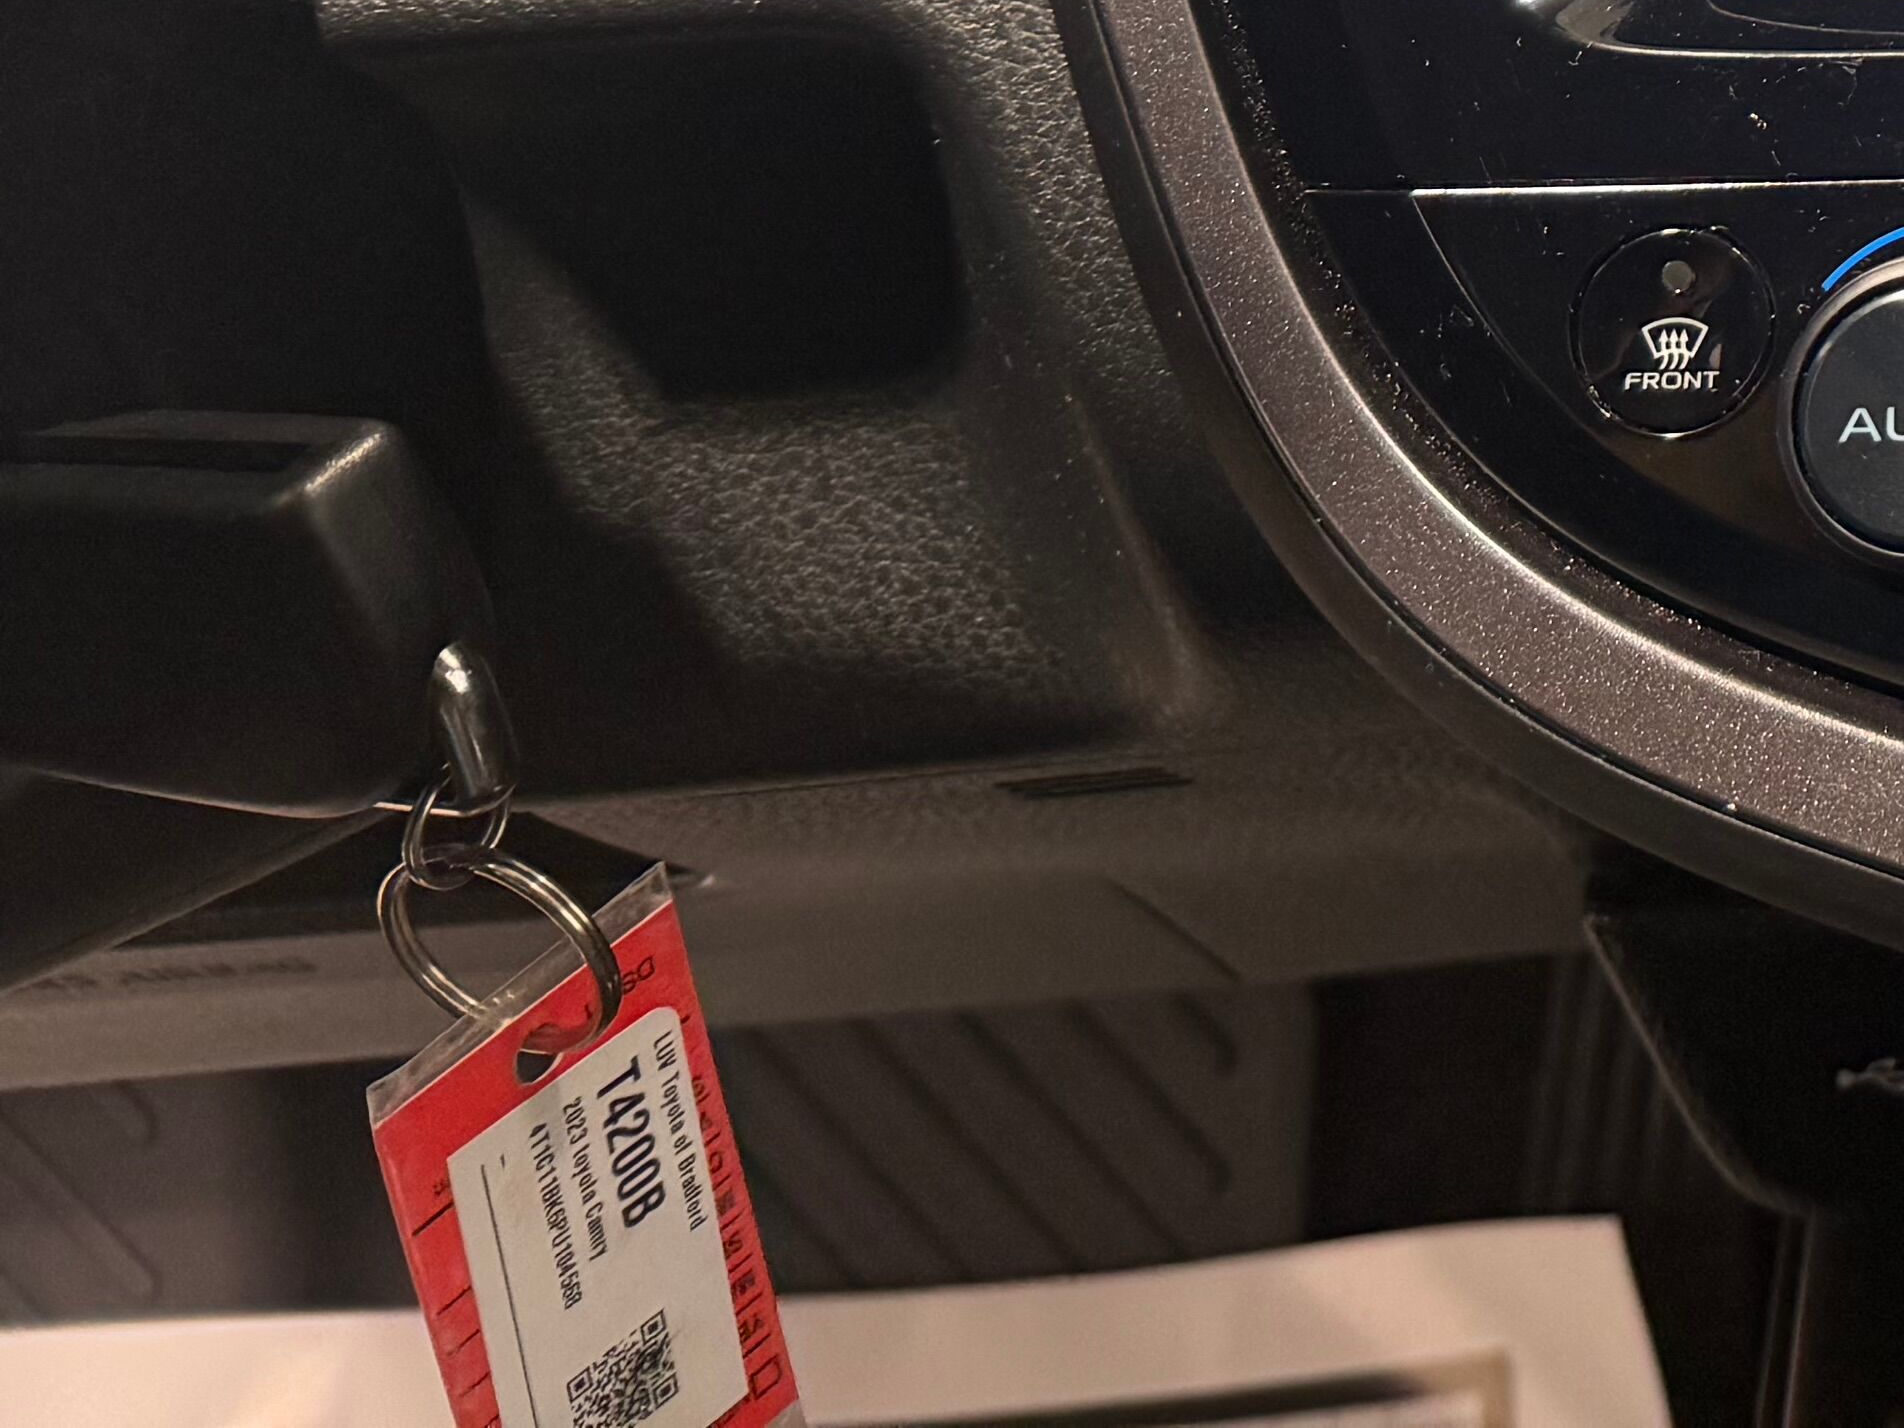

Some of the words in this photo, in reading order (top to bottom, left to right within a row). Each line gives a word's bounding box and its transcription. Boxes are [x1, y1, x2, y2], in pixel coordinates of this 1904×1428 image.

[1624, 370, 1720, 392] FRONT
[653, 1030, 677, 1072] LUV
[660, 1071, 685, 1136] Toyota
[597, 1054, 667, 1229] T4200B
[673, 1133, 693, 1156] of
[563, 1095, 588, 1146] 2023
[585, 1201, 608, 1262] Camry
[678, 1152, 708, 1233] Bradford
